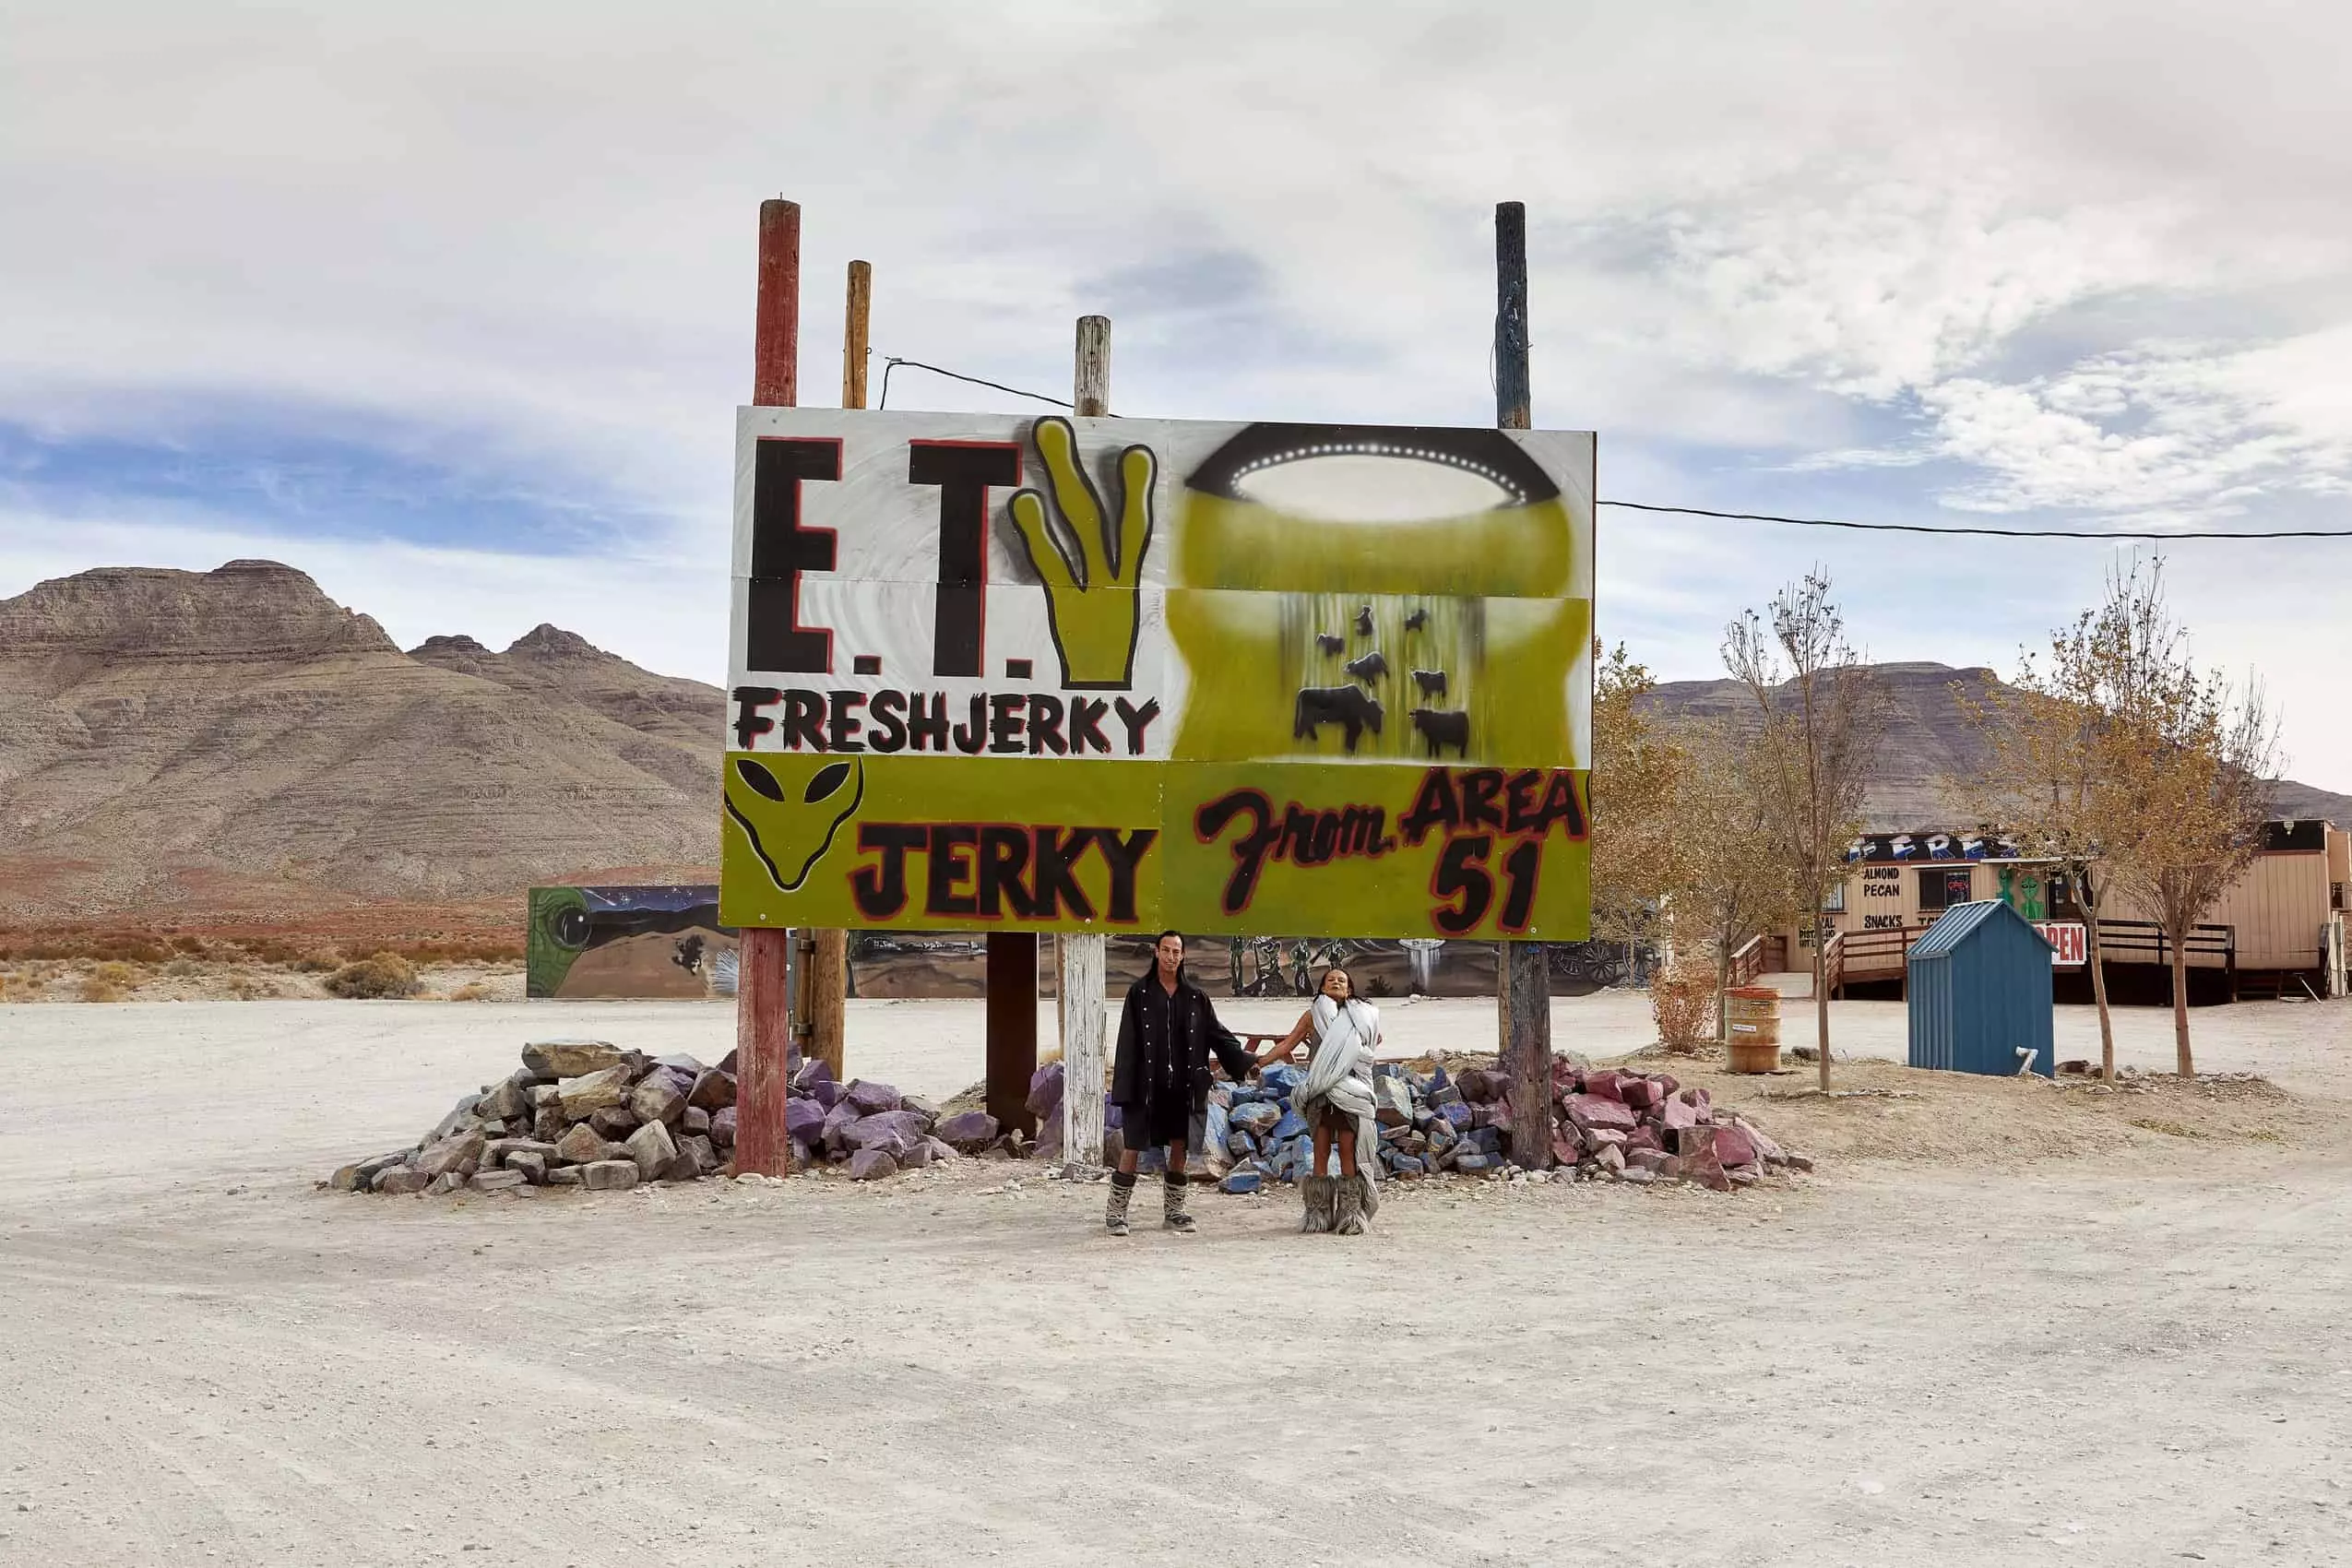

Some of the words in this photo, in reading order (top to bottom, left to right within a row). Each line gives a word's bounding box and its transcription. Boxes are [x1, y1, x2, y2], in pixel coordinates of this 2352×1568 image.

[1399, 766, 1589, 849] AREA
[847, 821, 1159, 924] JERKY
[1431, 834, 1547, 937] 51
[1863, 868, 1899, 879] ALMOND
[1863, 885, 1900, 897] PECAN
[1864, 915, 1903, 929] SNACKS
